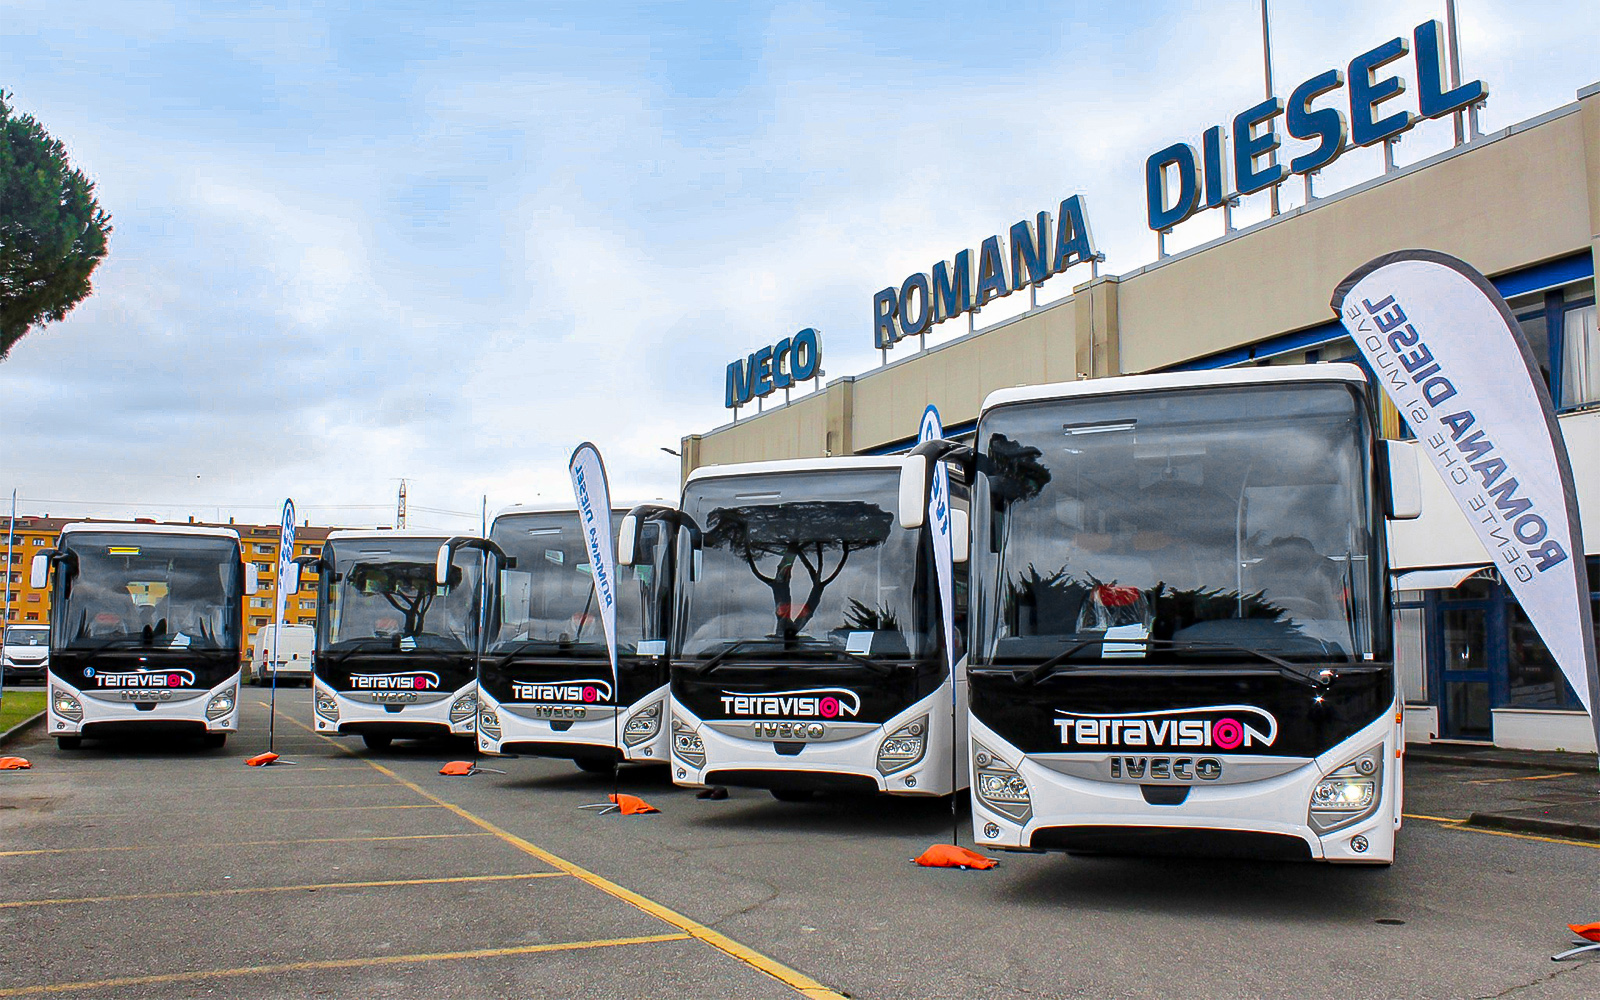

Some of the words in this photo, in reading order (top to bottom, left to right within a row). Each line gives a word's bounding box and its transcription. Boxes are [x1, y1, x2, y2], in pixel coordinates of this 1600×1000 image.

[726, 328, 821, 409] IVECO
[873, 194, 1097, 349] ROMANA
[1147, 19, 1489, 231] DIESEL
[535, 705, 587, 718] IVECO
[754, 722, 825, 738] IVECO
[1110, 756, 1222, 780] IVECO
